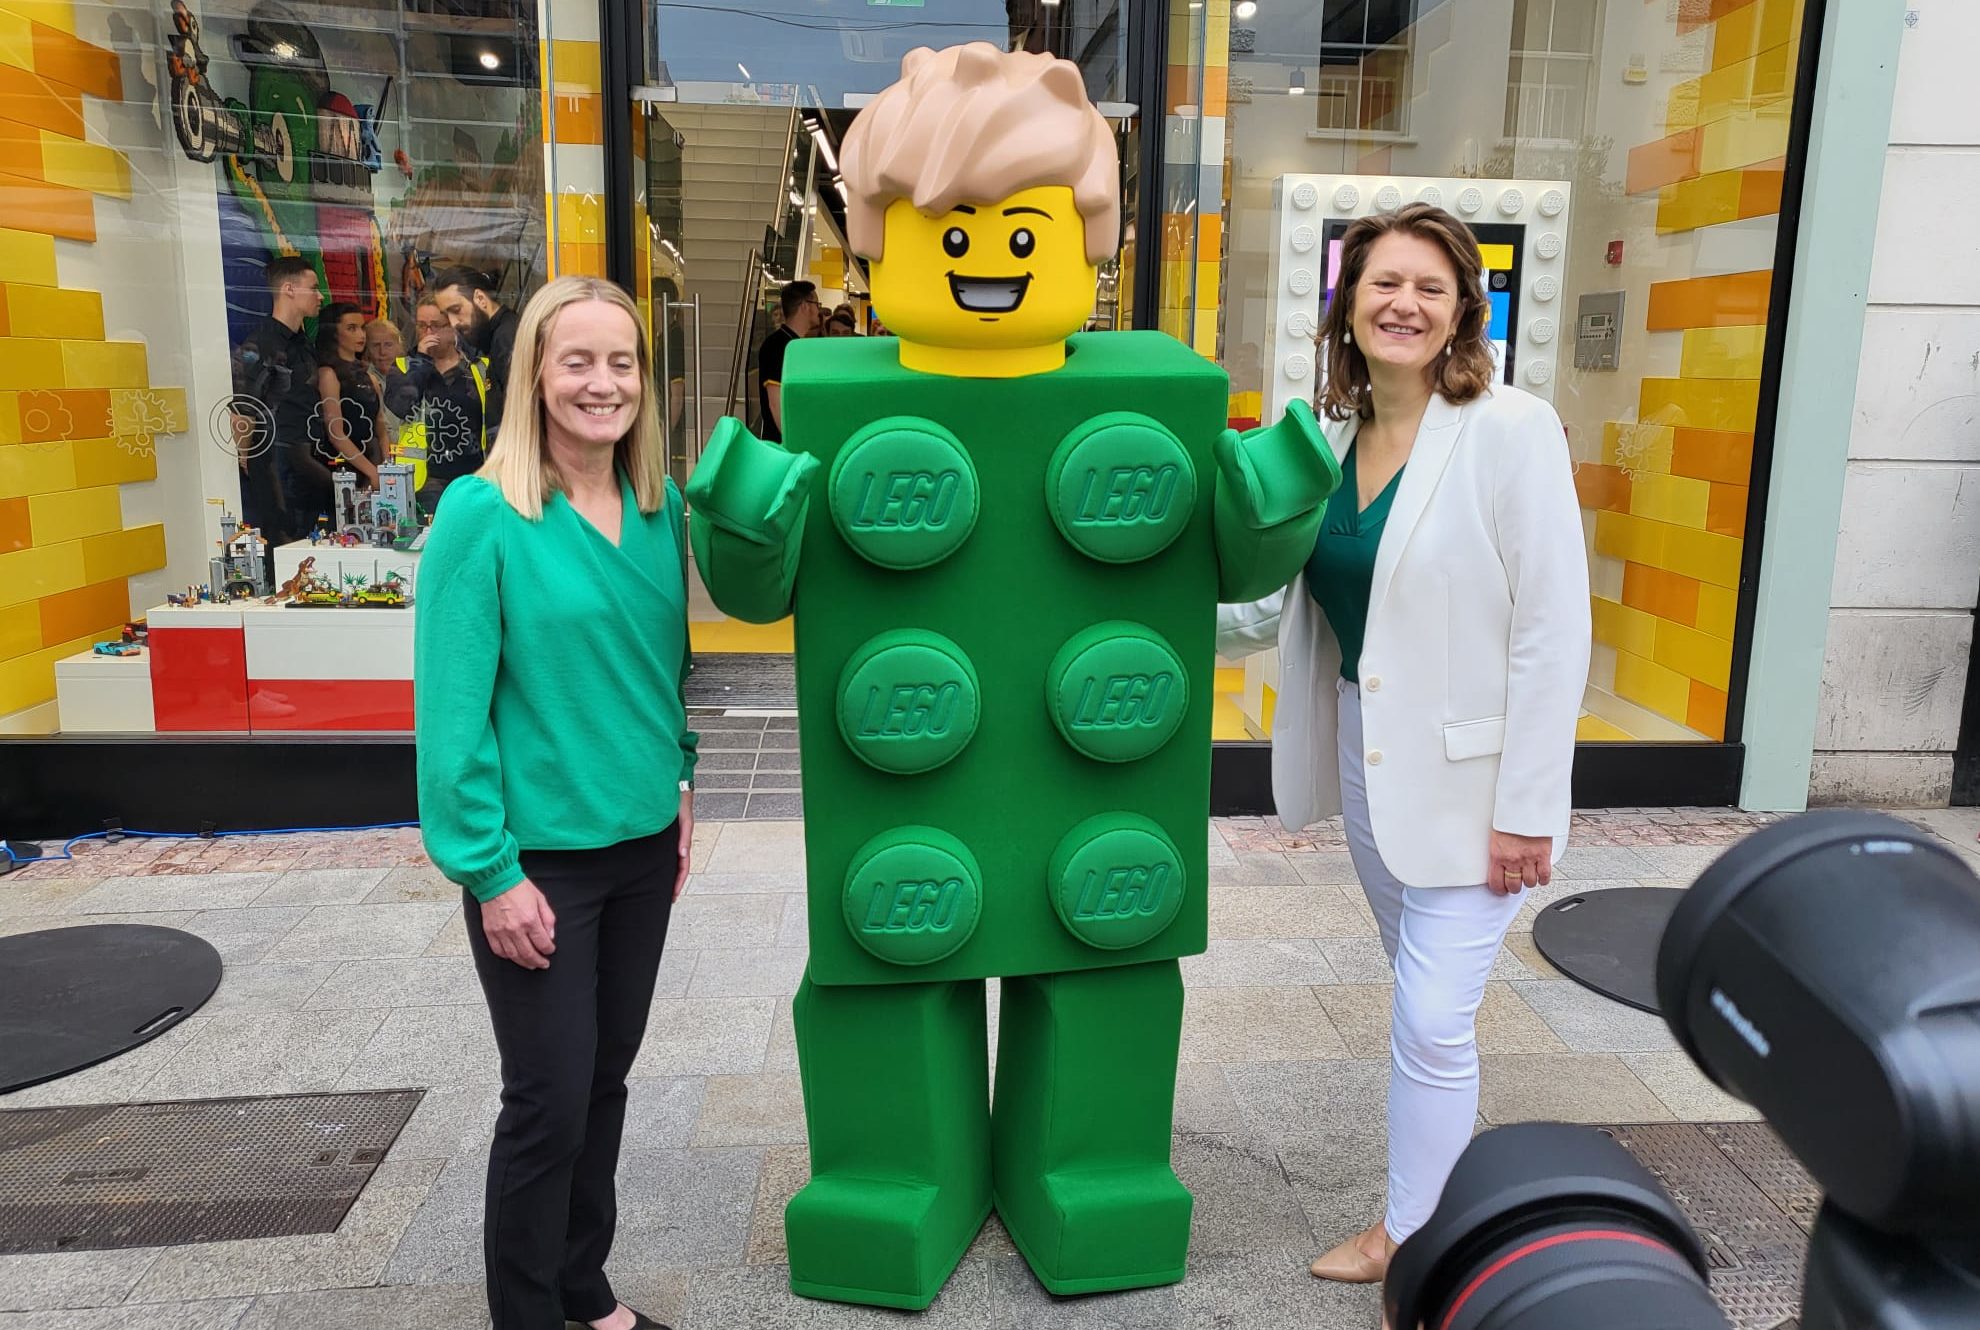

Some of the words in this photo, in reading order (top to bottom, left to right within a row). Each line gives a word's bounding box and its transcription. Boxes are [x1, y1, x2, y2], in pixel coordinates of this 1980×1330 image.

[852, 470, 959, 529] LEGO
[1074, 465, 1178, 526] LEGO
[857, 683, 960, 740] LEGO
[1073, 674, 1173, 730] LEGO
[863, 880, 963, 935] LEGO
[1074, 863, 1170, 920] LEGO
